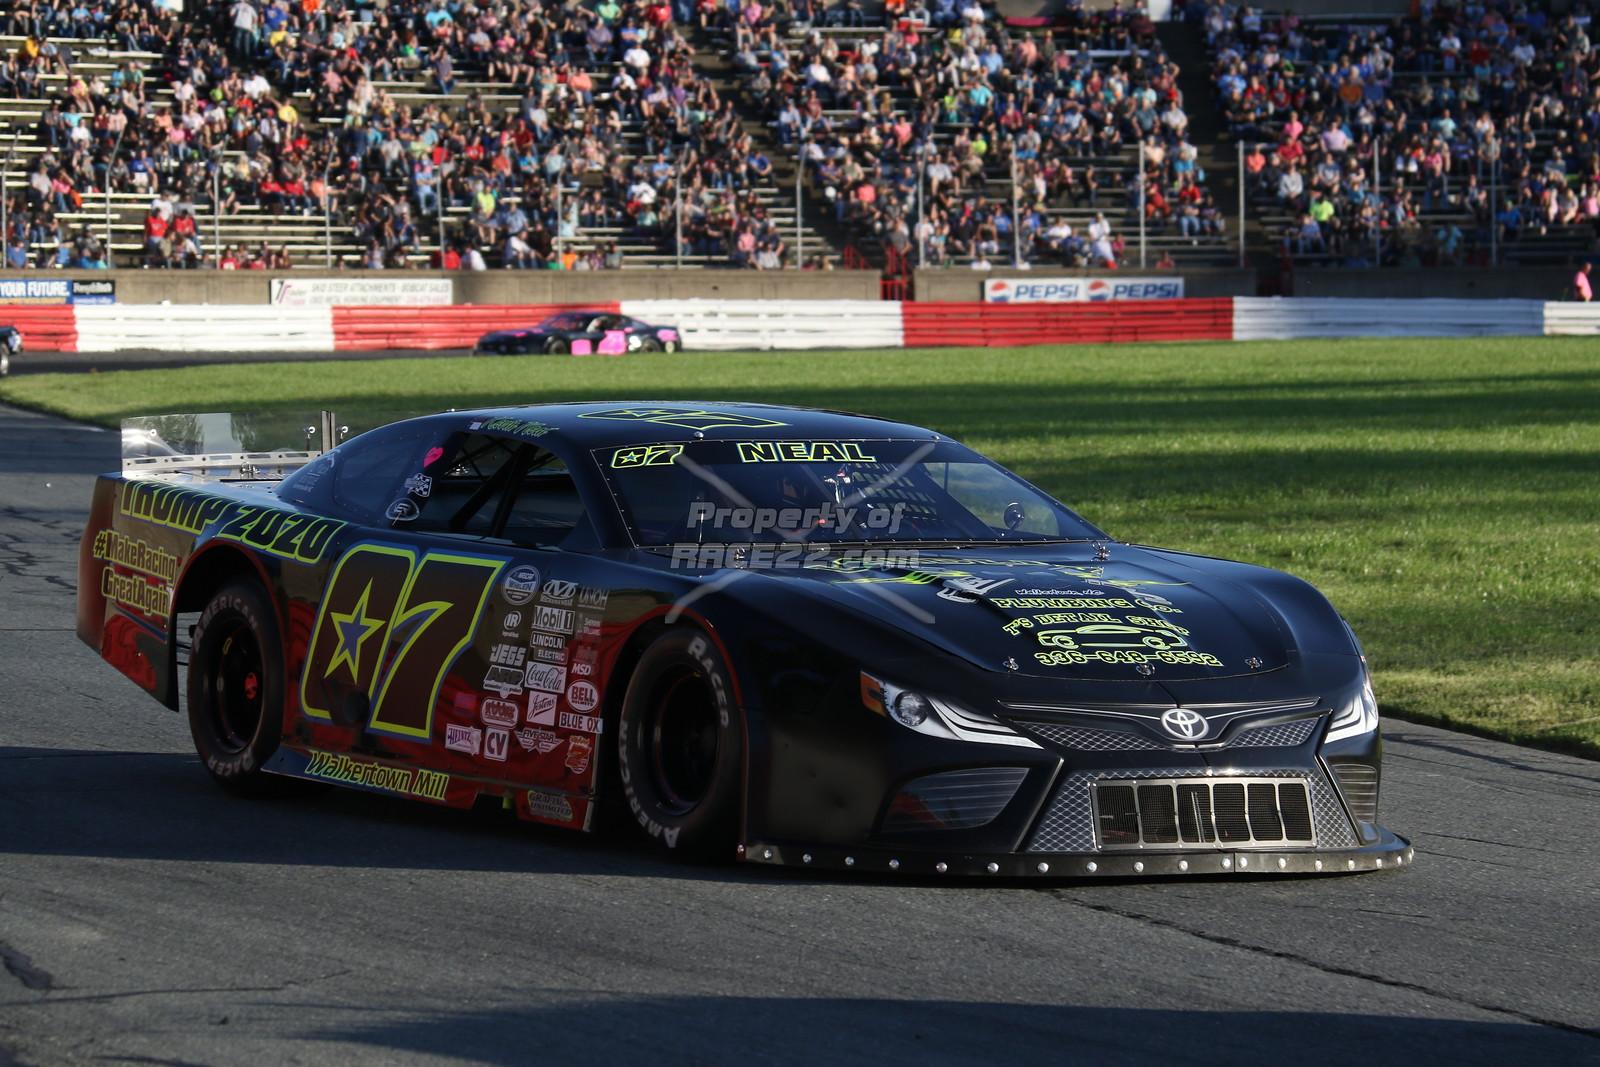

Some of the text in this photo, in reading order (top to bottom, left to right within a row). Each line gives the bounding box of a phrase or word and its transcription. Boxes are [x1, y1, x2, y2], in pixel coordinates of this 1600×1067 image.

[0, 281, 26, 297] YOUR
[1015, 283, 1079, 299] PEPSI
[1113, 282, 1179, 298] PEPSI
[736, 441, 876, 464] NEAL
[218, 504, 349, 564] 2020
[101, 567, 170, 619] GreatAgain
[989, 598, 1135, 609] PLUMBING
[534, 605, 563, 630] Mobil
[1033, 613, 1122, 624] DETAIL
[532, 634, 564, 649] LINCOLN
[490, 643, 526, 667] JEGS
[537, 649, 565, 662] ELECTRIC
[571, 662, 592, 676] MSD
[688, 635, 729, 728] RACER
[571, 685, 595, 703] BELL
[560, 713, 600, 733] BLUE OX
[486, 731, 507, 757] CV
[304, 750, 449, 801] Walkertown Mill
[618, 719, 680, 849] AMERICAN
